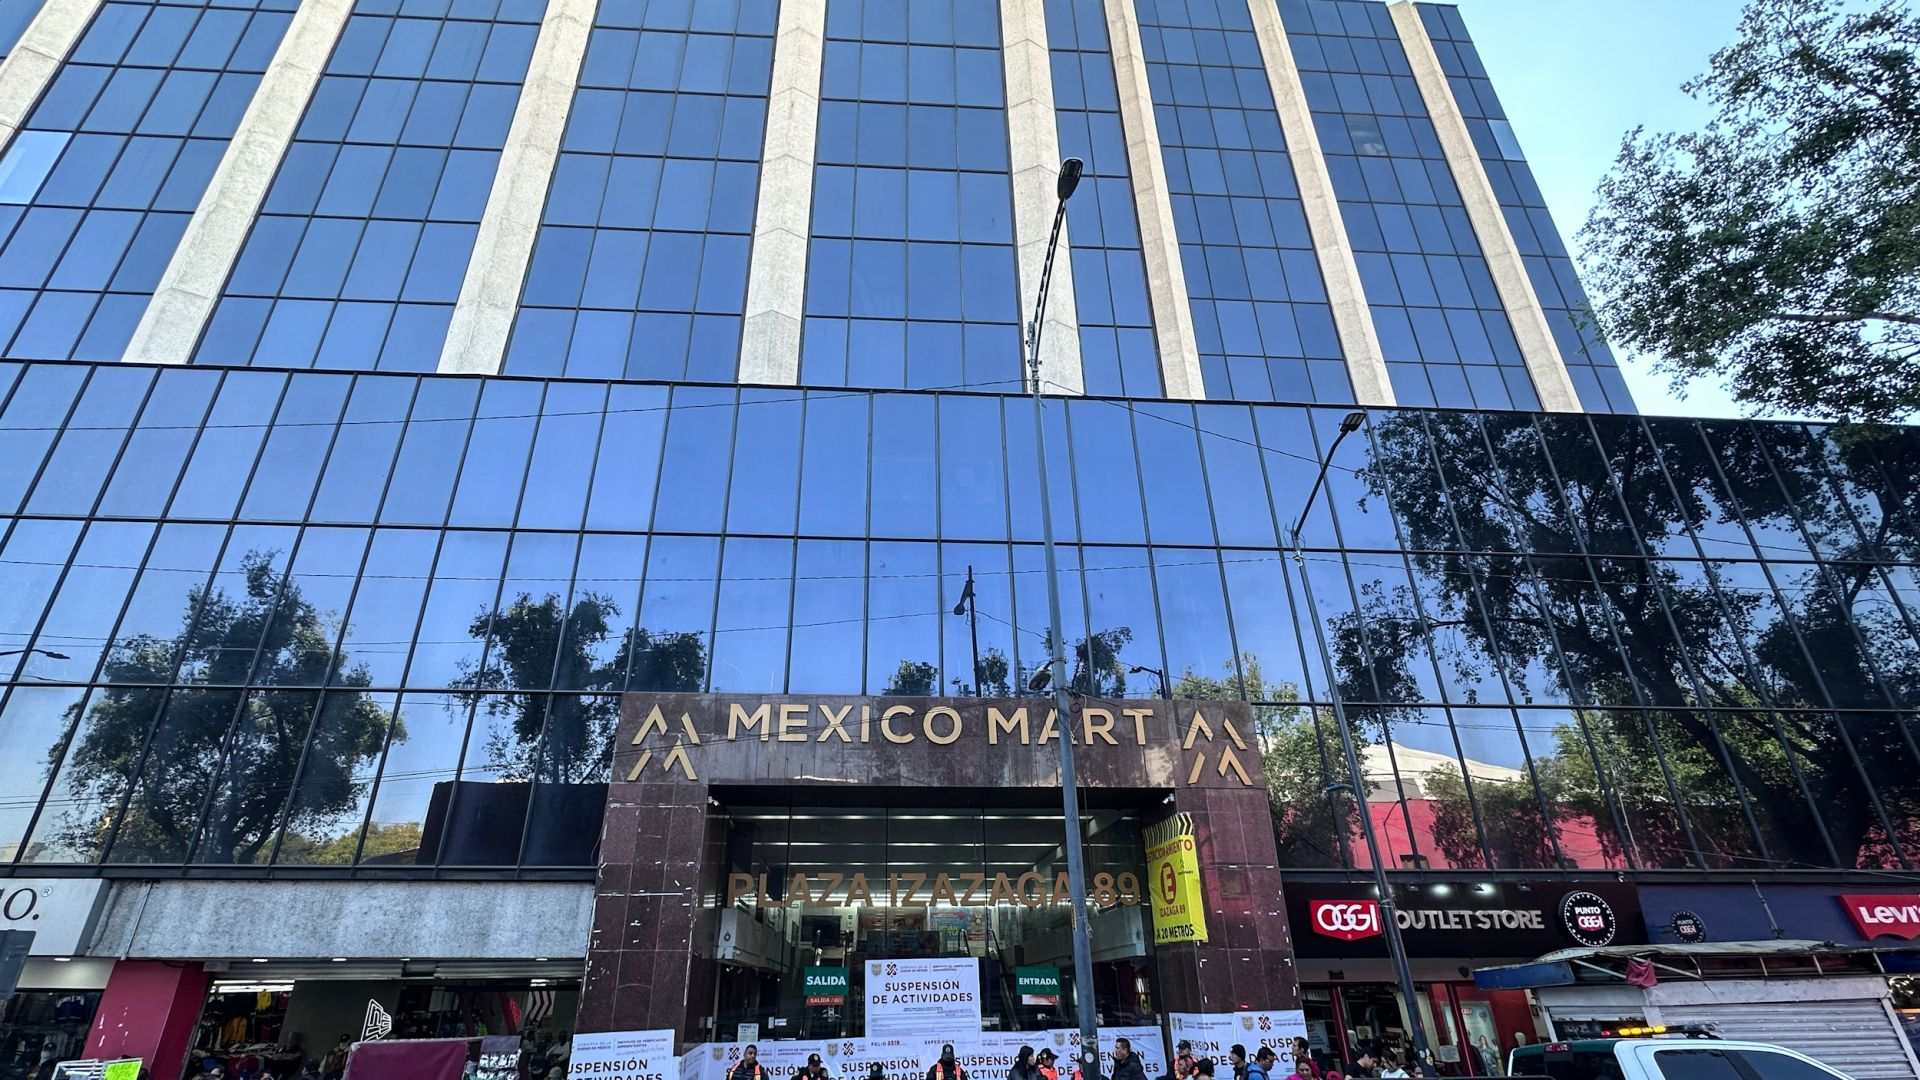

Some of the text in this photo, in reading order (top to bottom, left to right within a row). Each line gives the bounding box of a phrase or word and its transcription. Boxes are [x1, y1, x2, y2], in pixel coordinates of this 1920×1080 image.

[727, 703, 1153, 745] MEXICO MART
[728, 871, 1141, 908] PLAZA IZAZAGA 89
[1575, 906, 1600, 914] PUNTO
[1858, 905, 1920, 924] Levi'
[1317, 904, 1378, 931] OGGI
[1396, 910, 1544, 929] OUTLET STORE
[1578, 915, 1604, 928] OGGI
[1169, 924, 1195, 938] METROS
[1680, 925, 1697, 934] OGGI
[806, 976, 846, 985] SALIDA
[885, 979, 960, 992] SUSPENSIÓN
[1019, 977, 1058, 985] ENTRADA
[872, 992, 973, 1004] DE ACTIVIDADES
[568, 1057, 648, 1074] USPENSIÓN
[841, 1058, 919, 1073] SUSPNSIÓN
[955, 1056, 1020, 1066] SUSPENSI
[1058, 1066, 1073, 1076] DE
